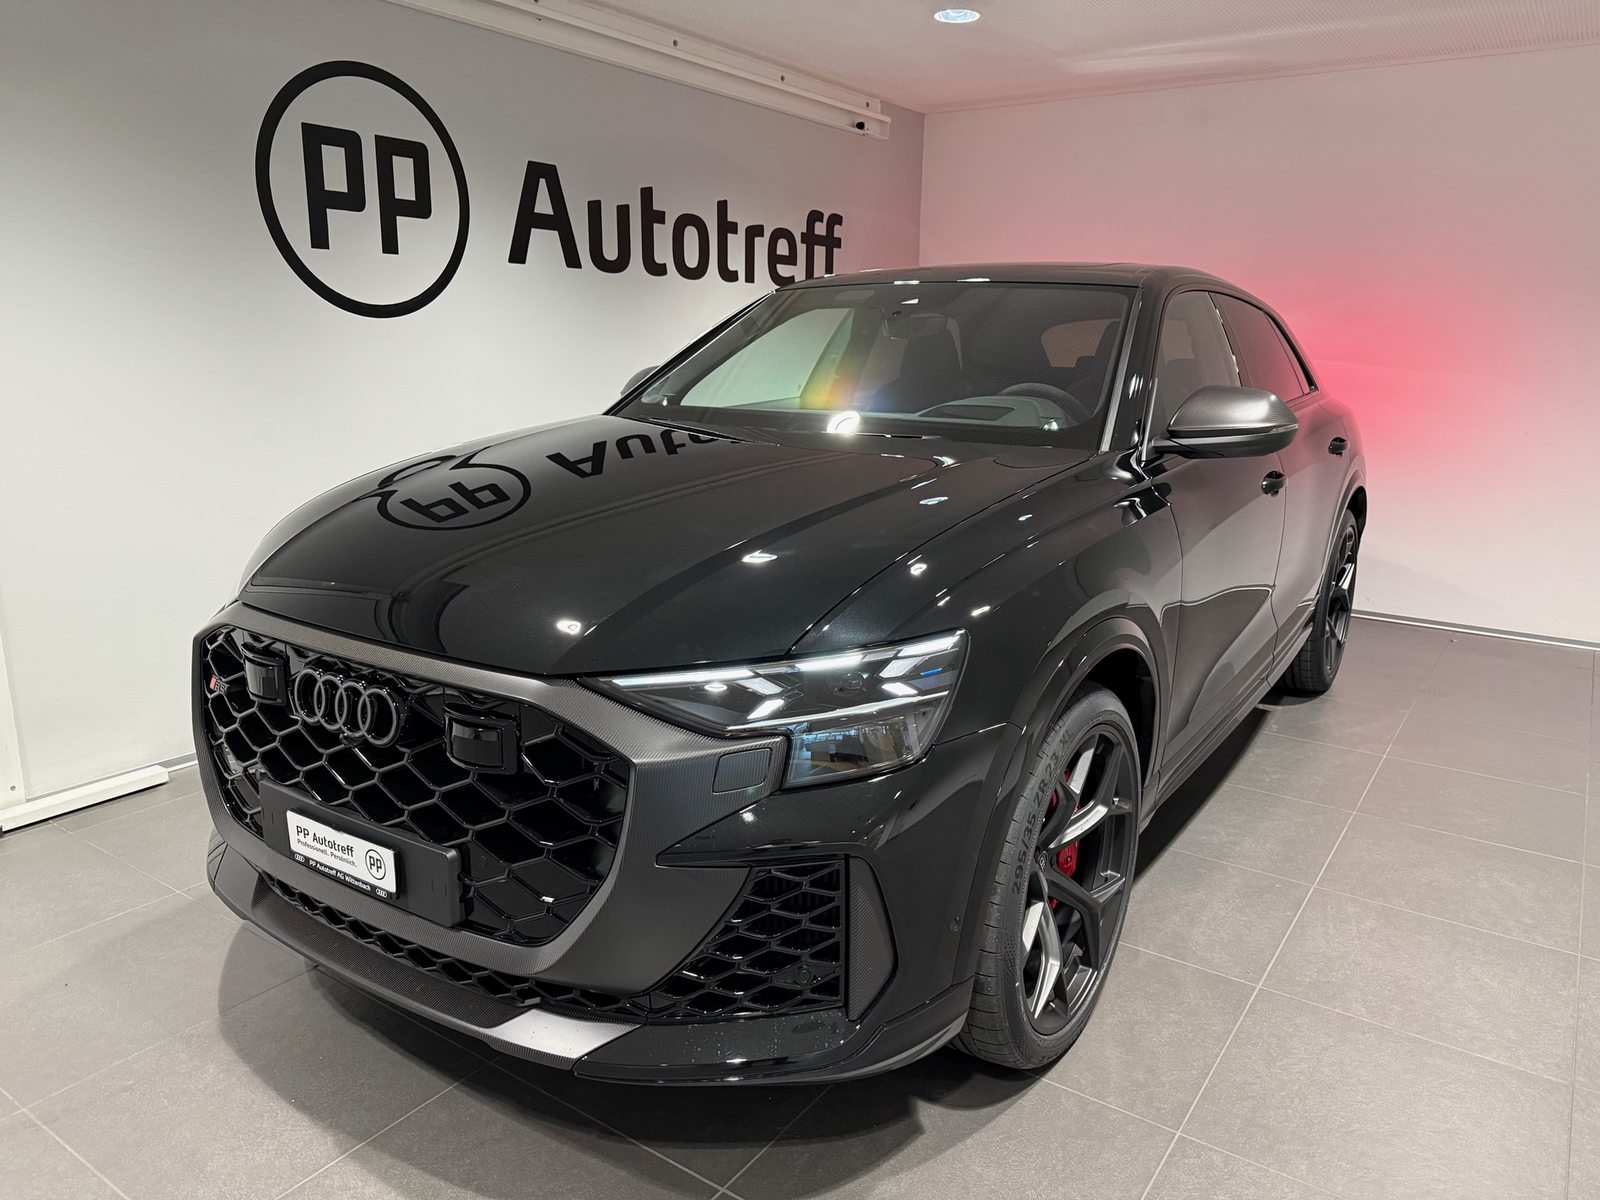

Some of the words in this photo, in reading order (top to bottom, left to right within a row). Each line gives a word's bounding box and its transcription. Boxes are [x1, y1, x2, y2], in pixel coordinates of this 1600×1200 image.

[301, 122, 432, 255] PP
[508, 160, 844, 287] Autotreff
[1012, 814, 1037, 894] 295/35
[1034, 780, 1049, 807] ZR
[1045, 753, 1060, 775] 23
[296, 825, 309, 838] PP
[312, 832, 354, 857] Autotreff
[309, 859, 316, 867] PP
[317, 863, 336, 876] Autotreff
[337, 872, 344, 880] AG
[369, 855, 383, 873] PP
